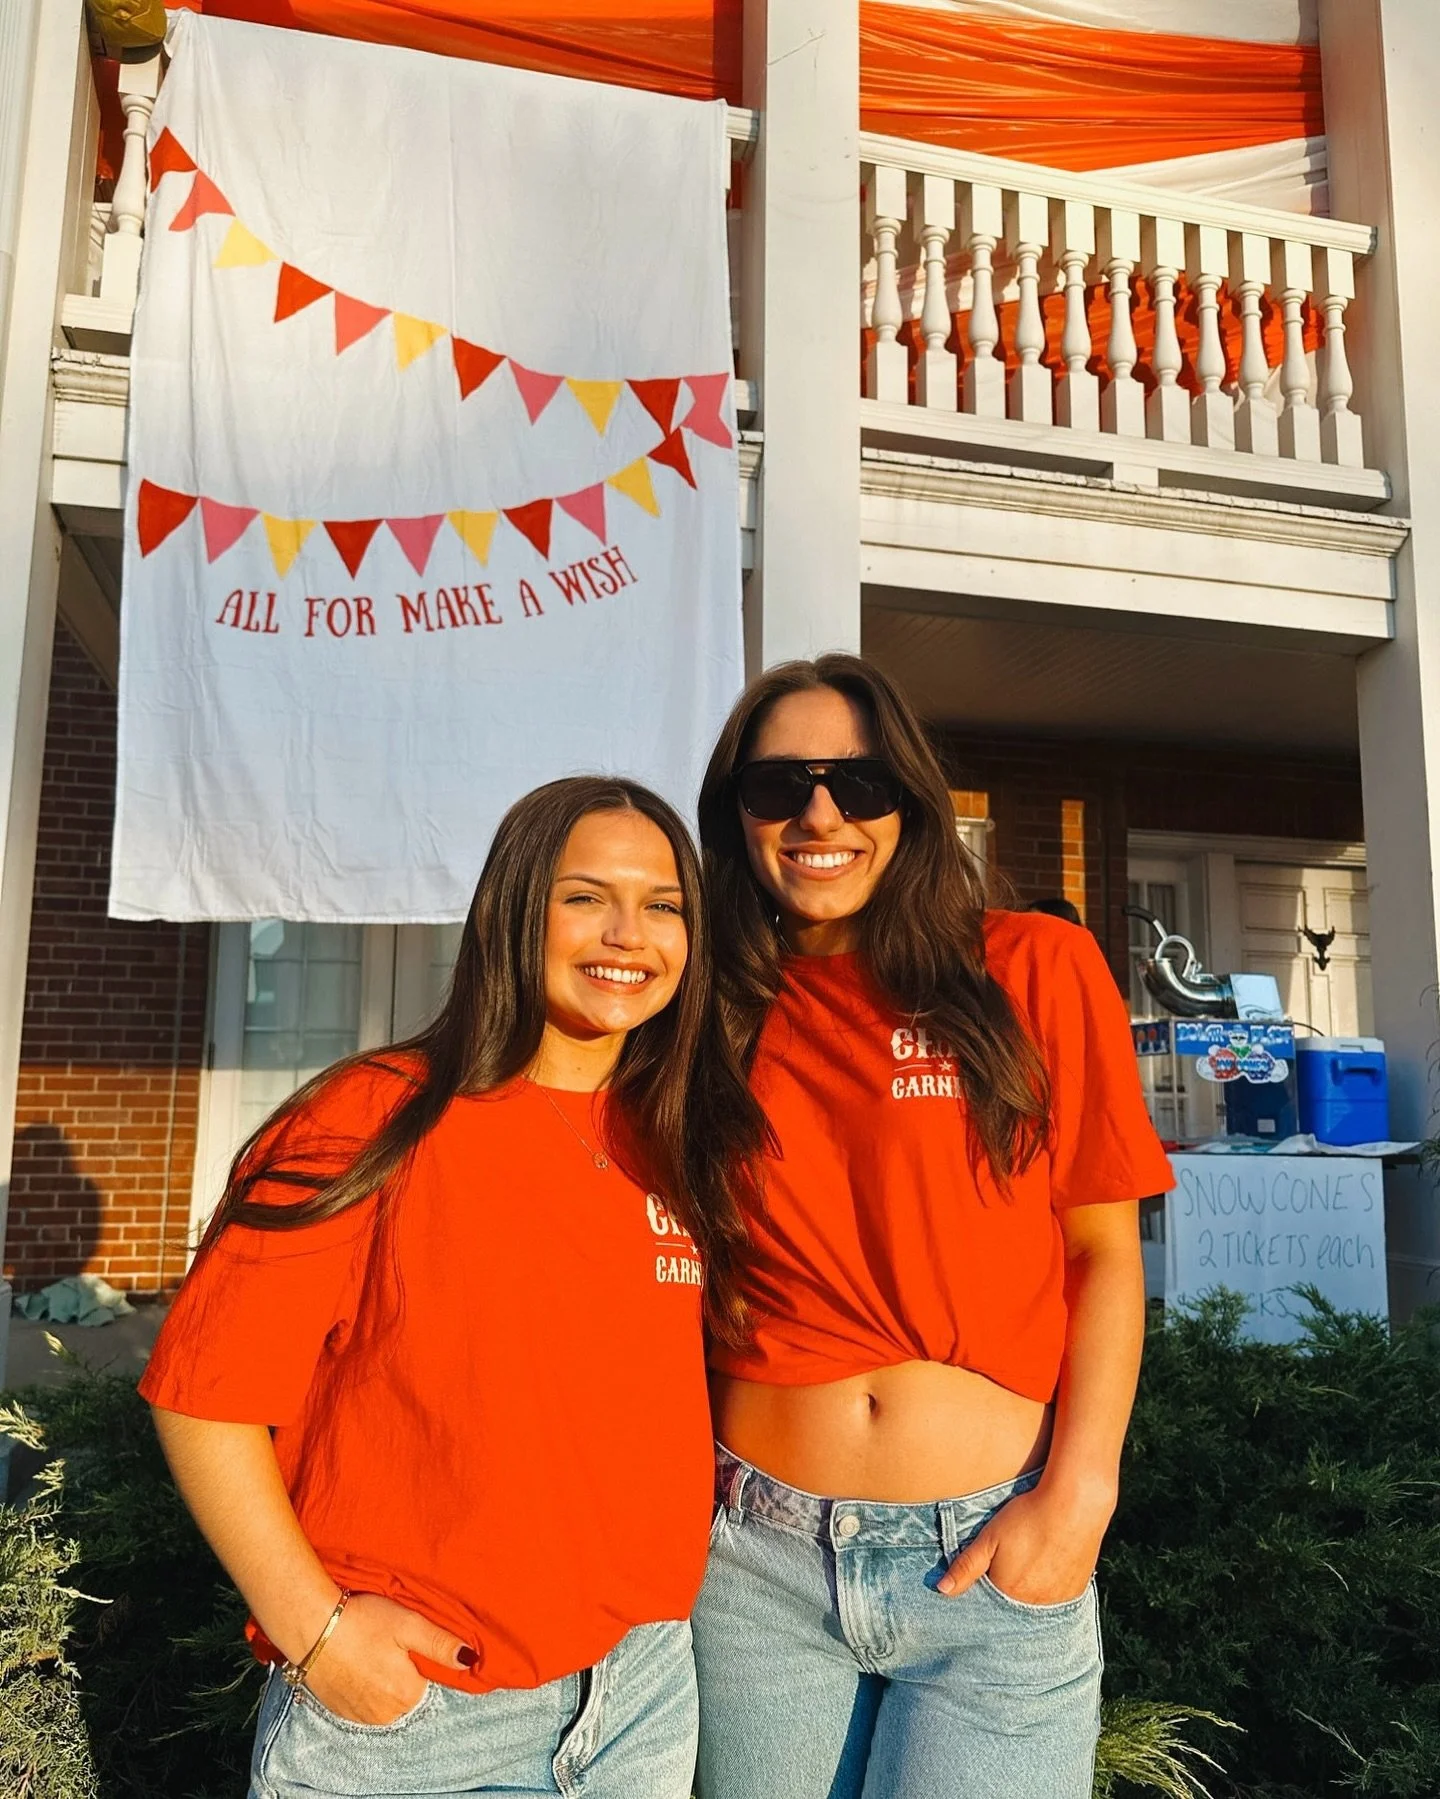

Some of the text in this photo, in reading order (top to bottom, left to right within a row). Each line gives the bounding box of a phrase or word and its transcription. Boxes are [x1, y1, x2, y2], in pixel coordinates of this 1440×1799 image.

[215, 545, 639, 639] ALL FOR MAKE A WISH
[1198, 1229, 1375, 1270] 2 TICKETS each
